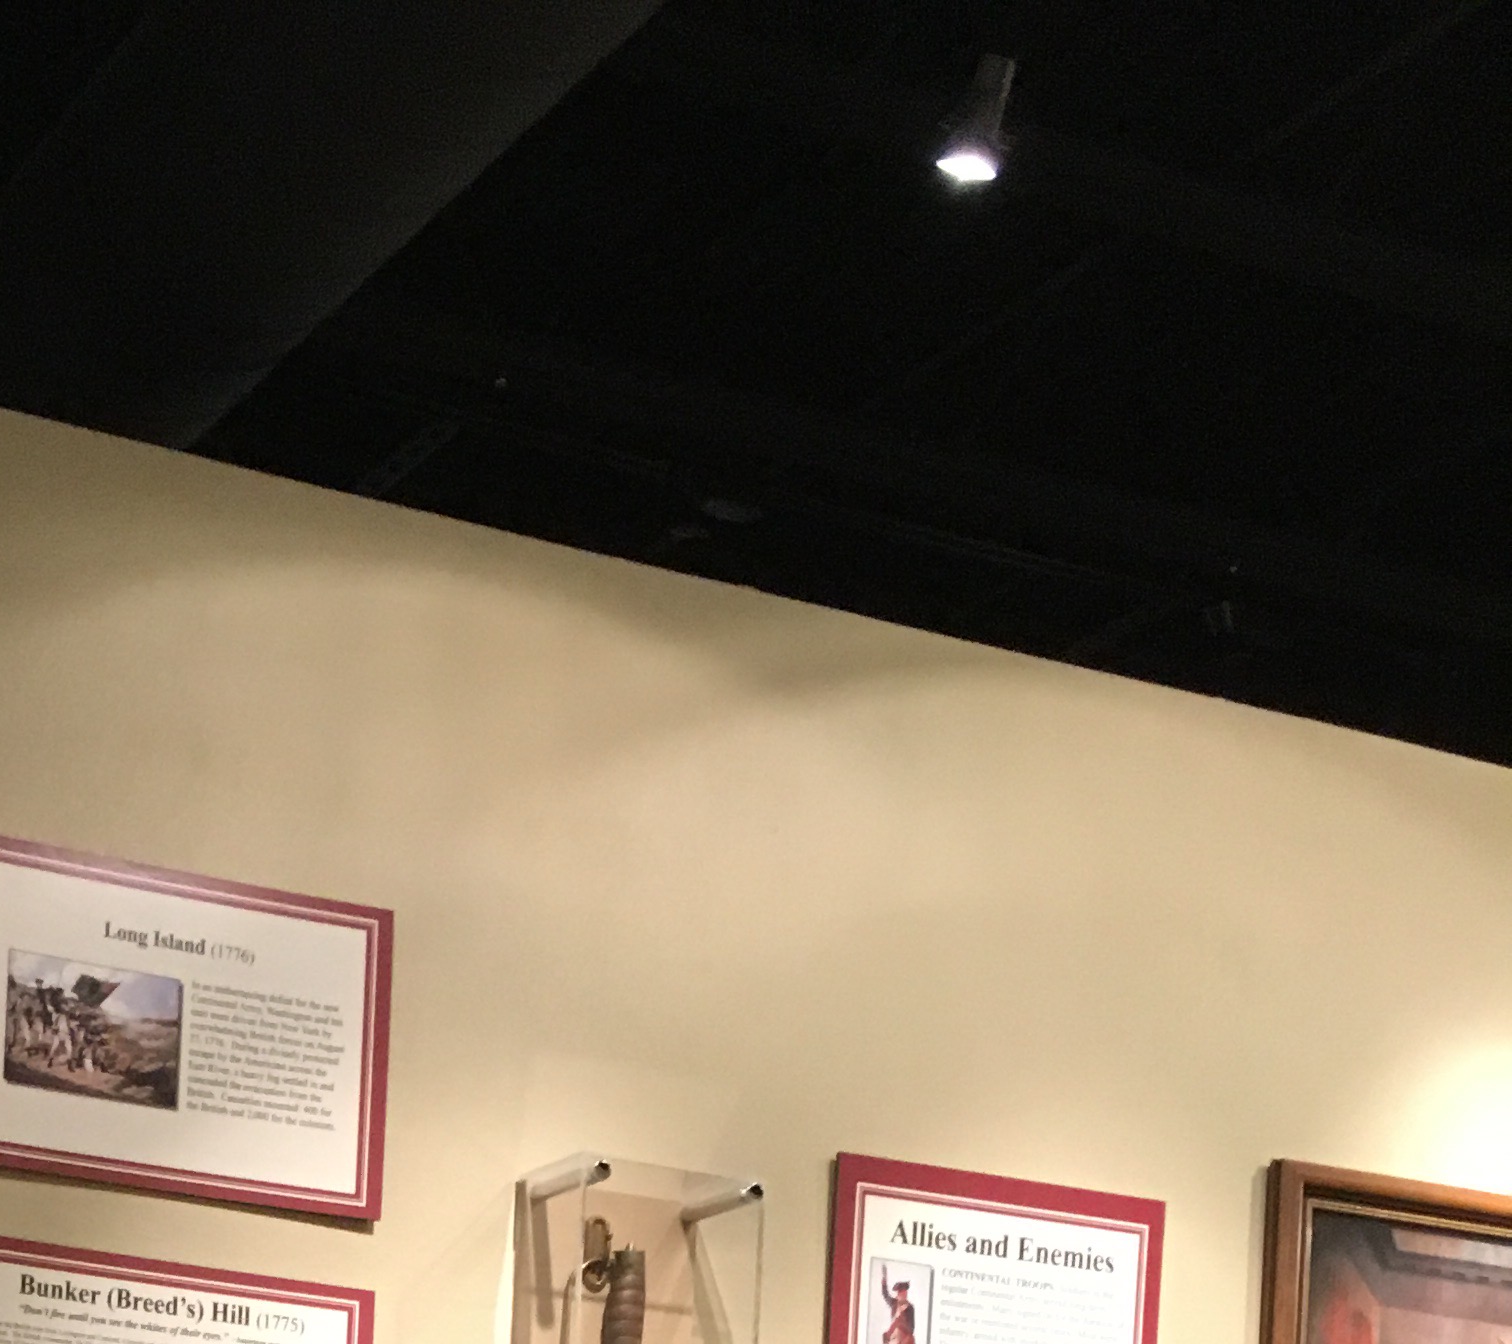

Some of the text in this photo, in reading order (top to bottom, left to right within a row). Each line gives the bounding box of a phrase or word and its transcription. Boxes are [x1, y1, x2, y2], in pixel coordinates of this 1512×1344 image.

[103, 920, 256, 967] Long Island (1776)
[889, 1217, 1116, 1275] Allies and Enemies
[19, 1273, 306, 1336] Bunker (Breed's) Hill (1775)
[124, 1317, 139, 1330] the
[140, 1320, 169, 1335] whites
[169, 1324, 180, 1338] of
